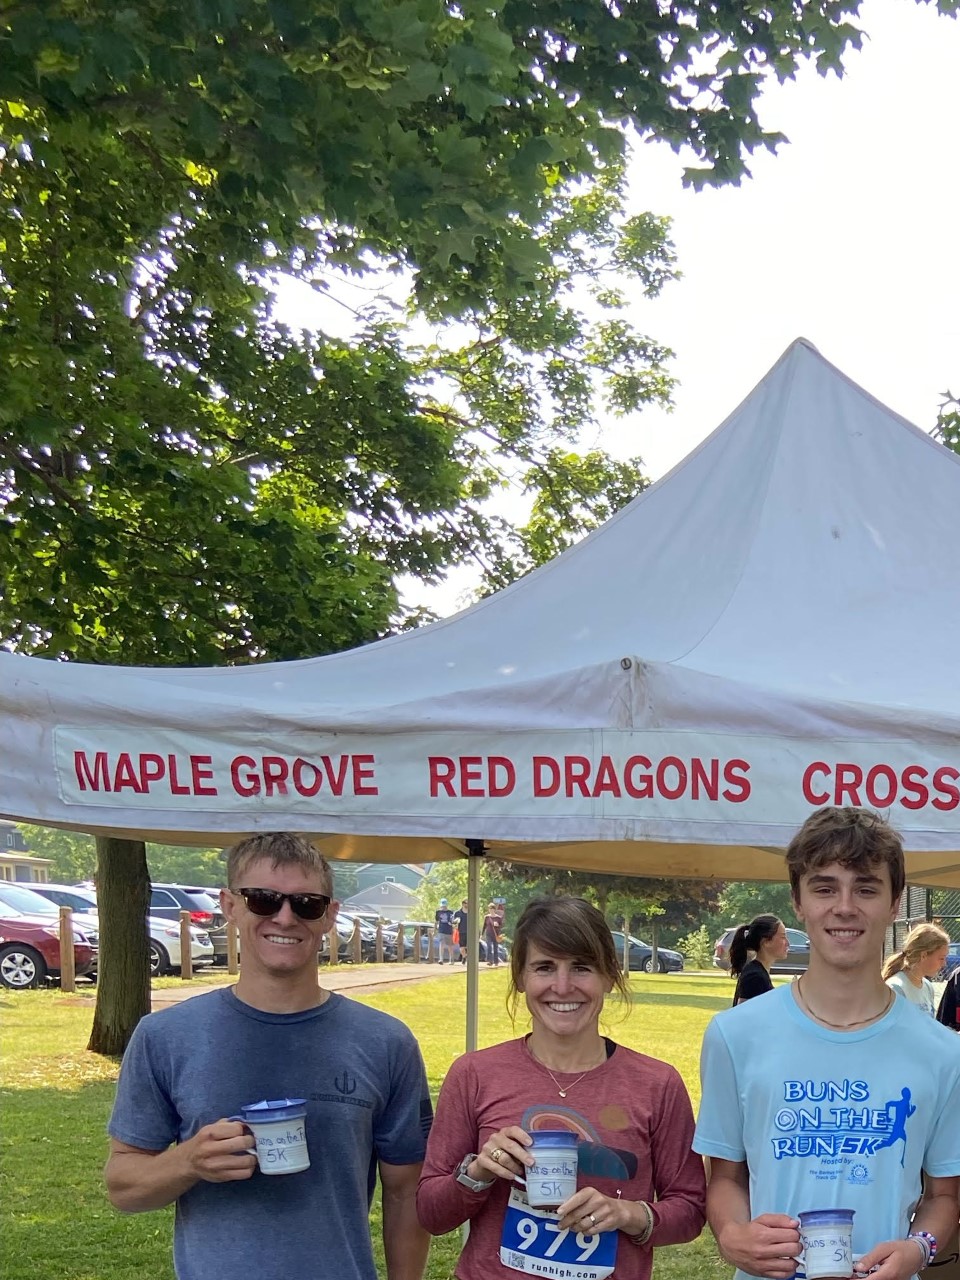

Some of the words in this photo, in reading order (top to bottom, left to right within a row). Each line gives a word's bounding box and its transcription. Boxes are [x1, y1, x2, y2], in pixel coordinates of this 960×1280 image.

[74, 751, 218, 796] MAPLE
[231, 755, 379, 797] GROVE
[428, 756, 516, 798] RED
[533, 755, 752, 803] DRAGONS
[802, 761, 960, 811] CROSS
[784, 1079, 869, 1101] BUNS
[775, 1106, 822, 1132] ON
[830, 1106, 889, 1130] THE
[771, 1134, 838, 1160] RUN
[838, 1136, 881, 1156] 5K
[517, 1217, 601, 1262] 979
[531, 1263, 598, 1279] runhigh.com
